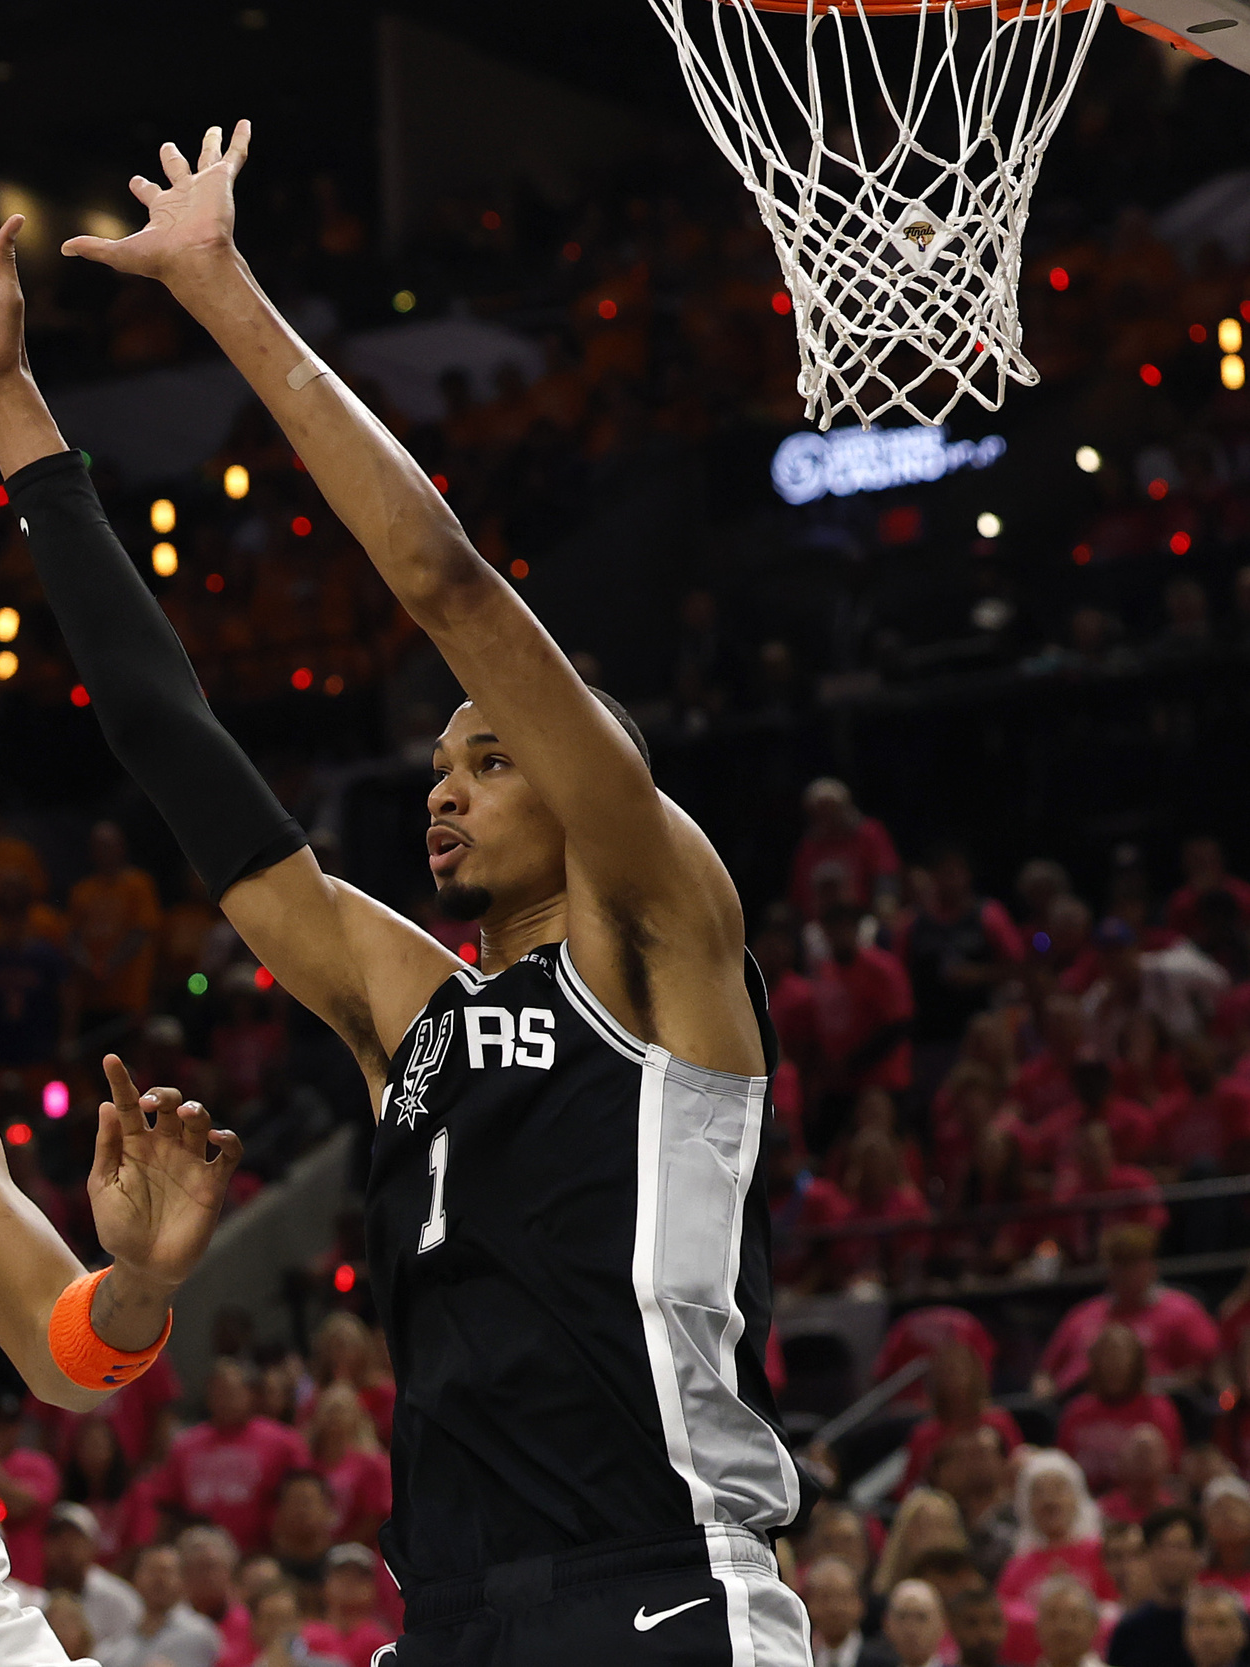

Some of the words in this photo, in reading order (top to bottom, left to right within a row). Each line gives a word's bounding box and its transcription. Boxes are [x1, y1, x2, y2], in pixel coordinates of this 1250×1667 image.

[902, 225, 936, 240] Finals
[519, 953, 548, 968] GER
[417, 1126, 450, 1255] 1
